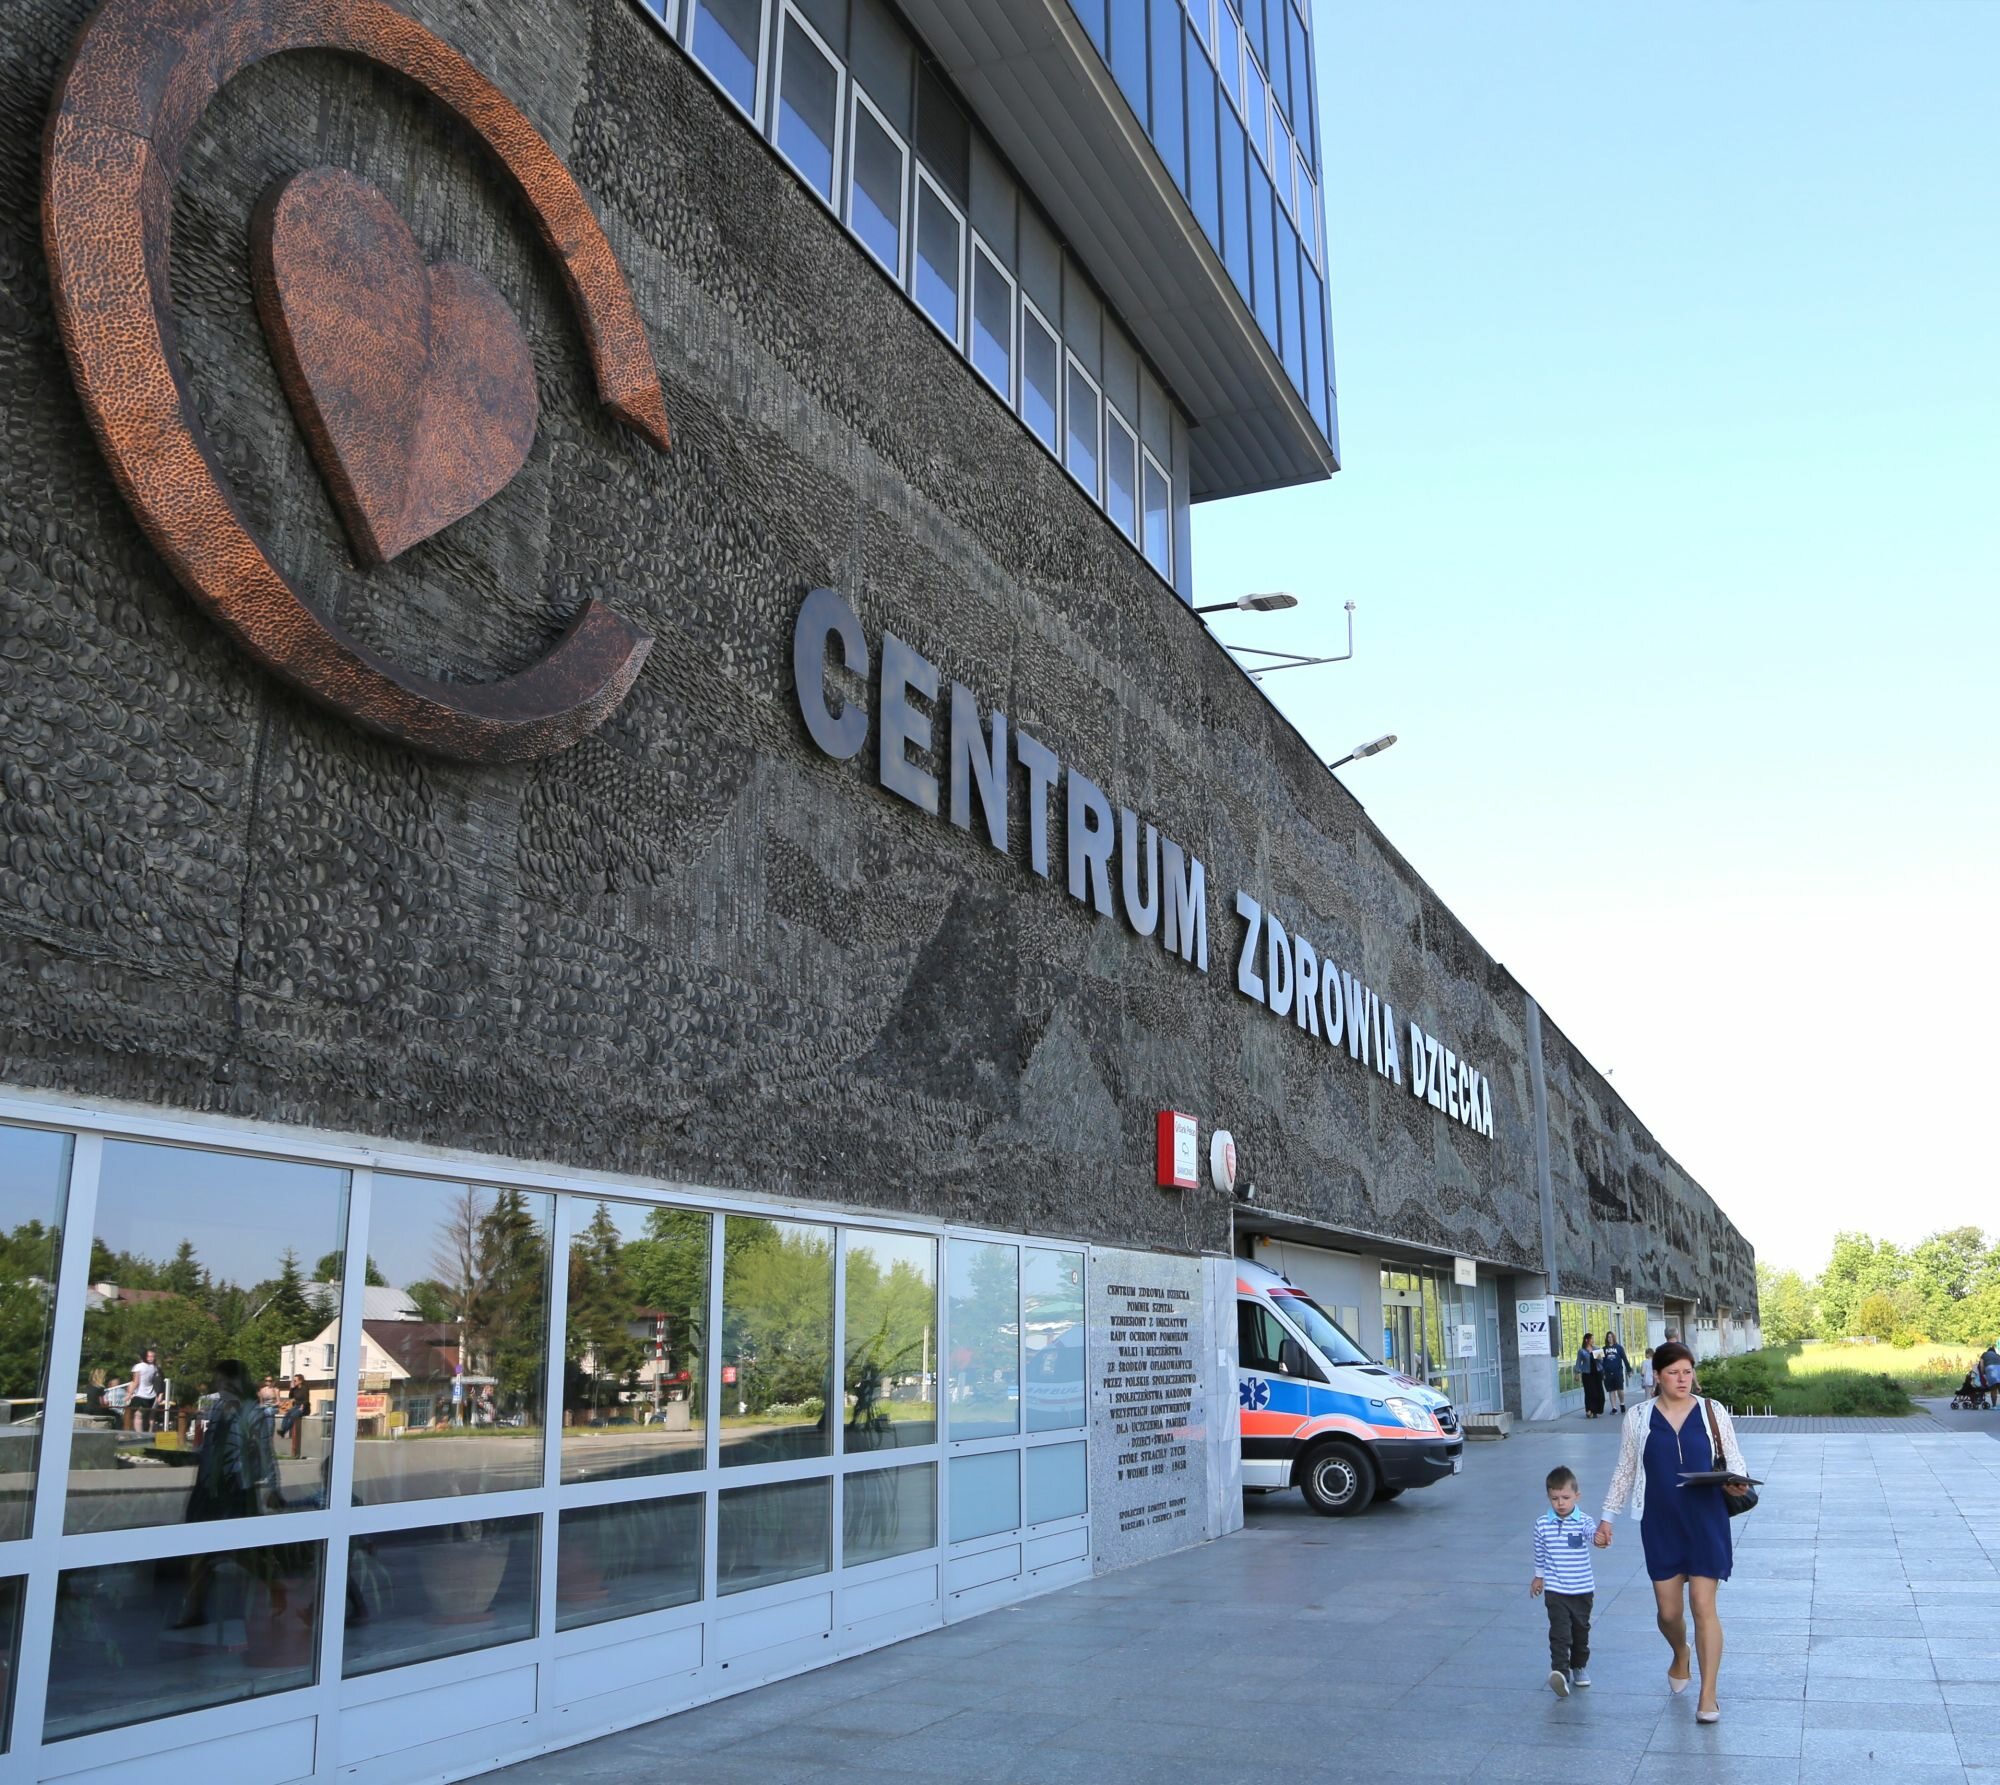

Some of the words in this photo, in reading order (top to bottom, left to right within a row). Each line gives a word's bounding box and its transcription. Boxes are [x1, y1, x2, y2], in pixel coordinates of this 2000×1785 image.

[794, 587, 1208, 973] CENTRUM
[1236, 891, 1401, 1086] ZDROWIA
[1410, 1021, 1495, 1140] DZIECKA
[1107, 1285, 1135, 1296] CENTRUM
[1139, 1287, 1165, 1298] ZDROWIA
[1127, 1302, 1149, 1312] POMNIK
[1153, 1303, 1175, 1313] SZPITAL
[1149, 1318, 1154, 1327] Z
[1520, 1321, 1547, 1332] NFZ
[1111, 1332, 1126, 1341] RADY
[1130, 1332, 1157, 1341] OCHRONY
[1119, 1347, 1138, 1356] WALKI
[1141, 1347, 1144, 1356] I
[1107, 1362, 1115, 1373] ZE
[1104, 1378, 1122, 1388] PRZEZ
[1126, 1377, 1149, 1387] POLSKIE
[1110, 1394, 1113, 1404] I
[1110, 1407, 1148, 1419] WSZYSTKICH
[1117, 1424, 1128, 1434] DLA
[1132, 1437, 1150, 1447] DZIECI
[1118, 1471, 1123, 1481] W
